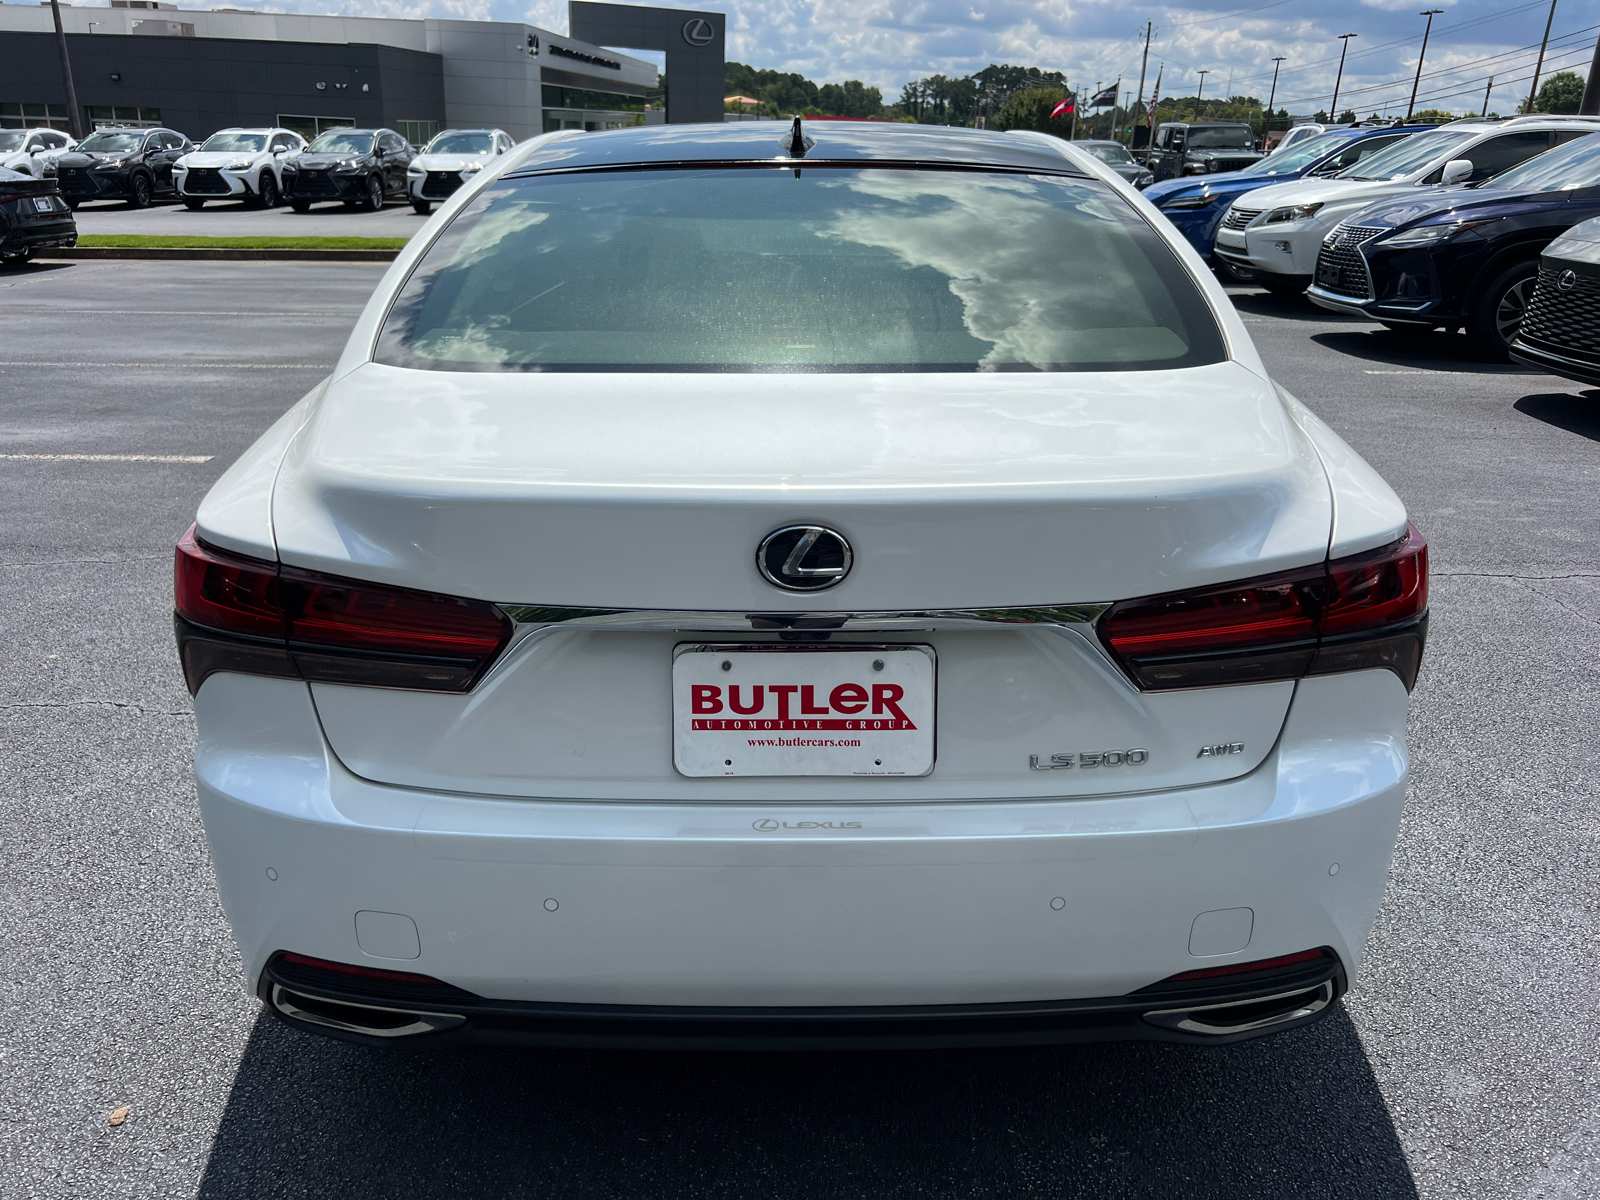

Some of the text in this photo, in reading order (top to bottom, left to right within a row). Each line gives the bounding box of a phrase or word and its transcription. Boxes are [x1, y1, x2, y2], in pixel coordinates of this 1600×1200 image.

[693, 720, 909, 730] AUTOMOTIVE GROUP
[747, 737, 861, 747] www.butlercars.com
[1197, 742, 1244, 759] AWD
[1029, 748, 1149, 771] LS 500
[782, 821, 862, 829] LEXUS
